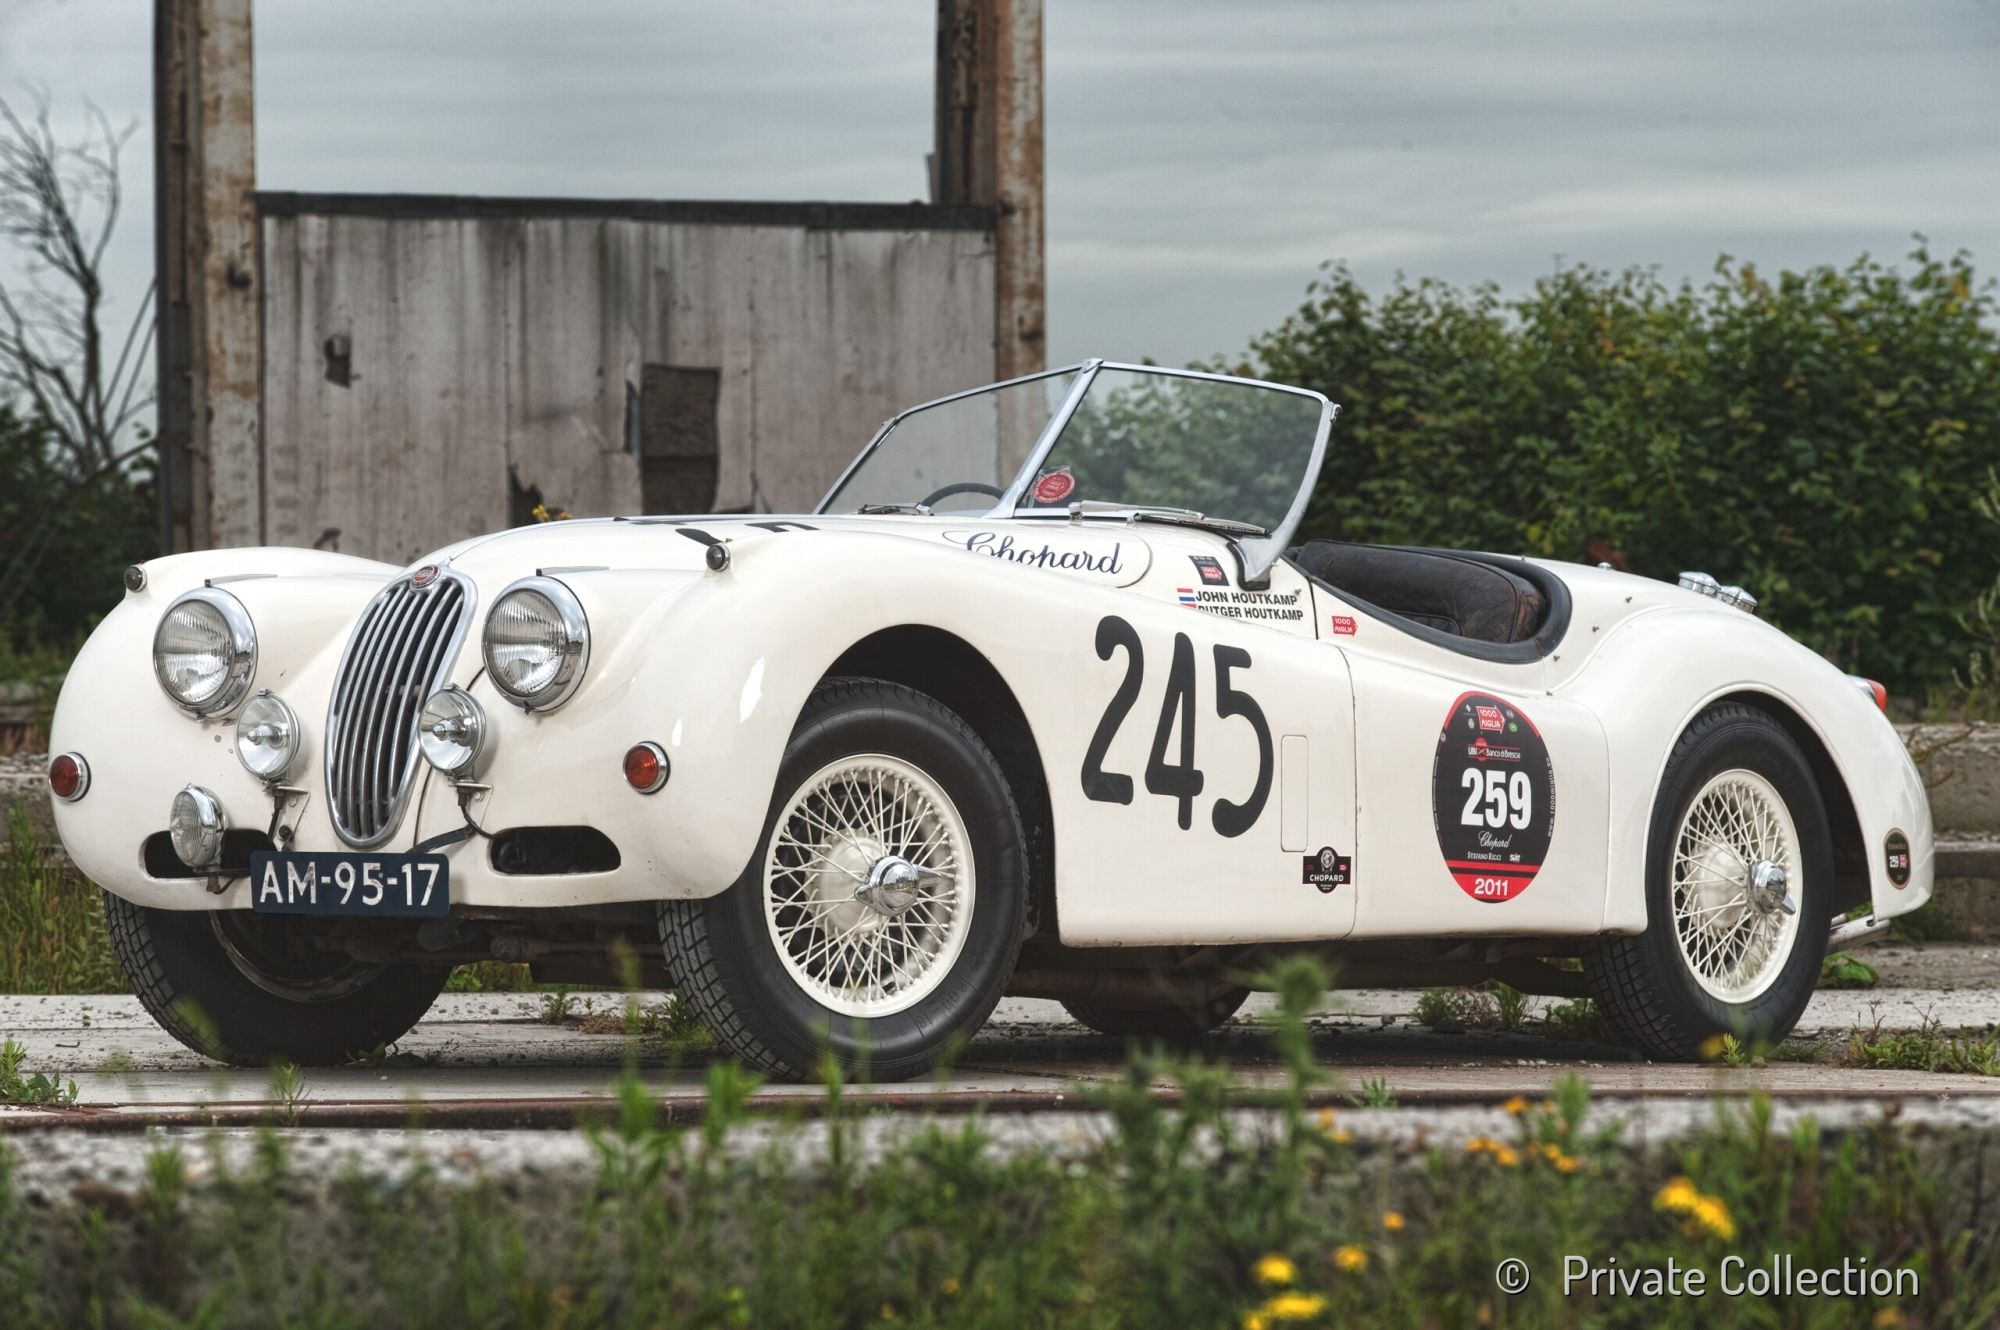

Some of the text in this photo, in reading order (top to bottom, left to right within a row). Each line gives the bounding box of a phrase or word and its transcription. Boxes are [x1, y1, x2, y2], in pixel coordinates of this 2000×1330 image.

[942, 531, 1123, 575] Chopard
[1196, 591, 1298, 606] JOHN HOUTKAMP
[1244, 607, 1304, 621] HOUTKAMP
[1480, 709, 1498, 717] 1000
[1081, 615, 1275, 838] 245
[1481, 720, 1501, 728] MIGLIA
[1461, 767, 1532, 830] 259
[1478, 831, 1512, 849] Chopard
[259, 860, 440, 907] AM-95-17
[1310, 874, 1343, 882] CHOPARD
[1474, 878, 1509, 896] 2011
